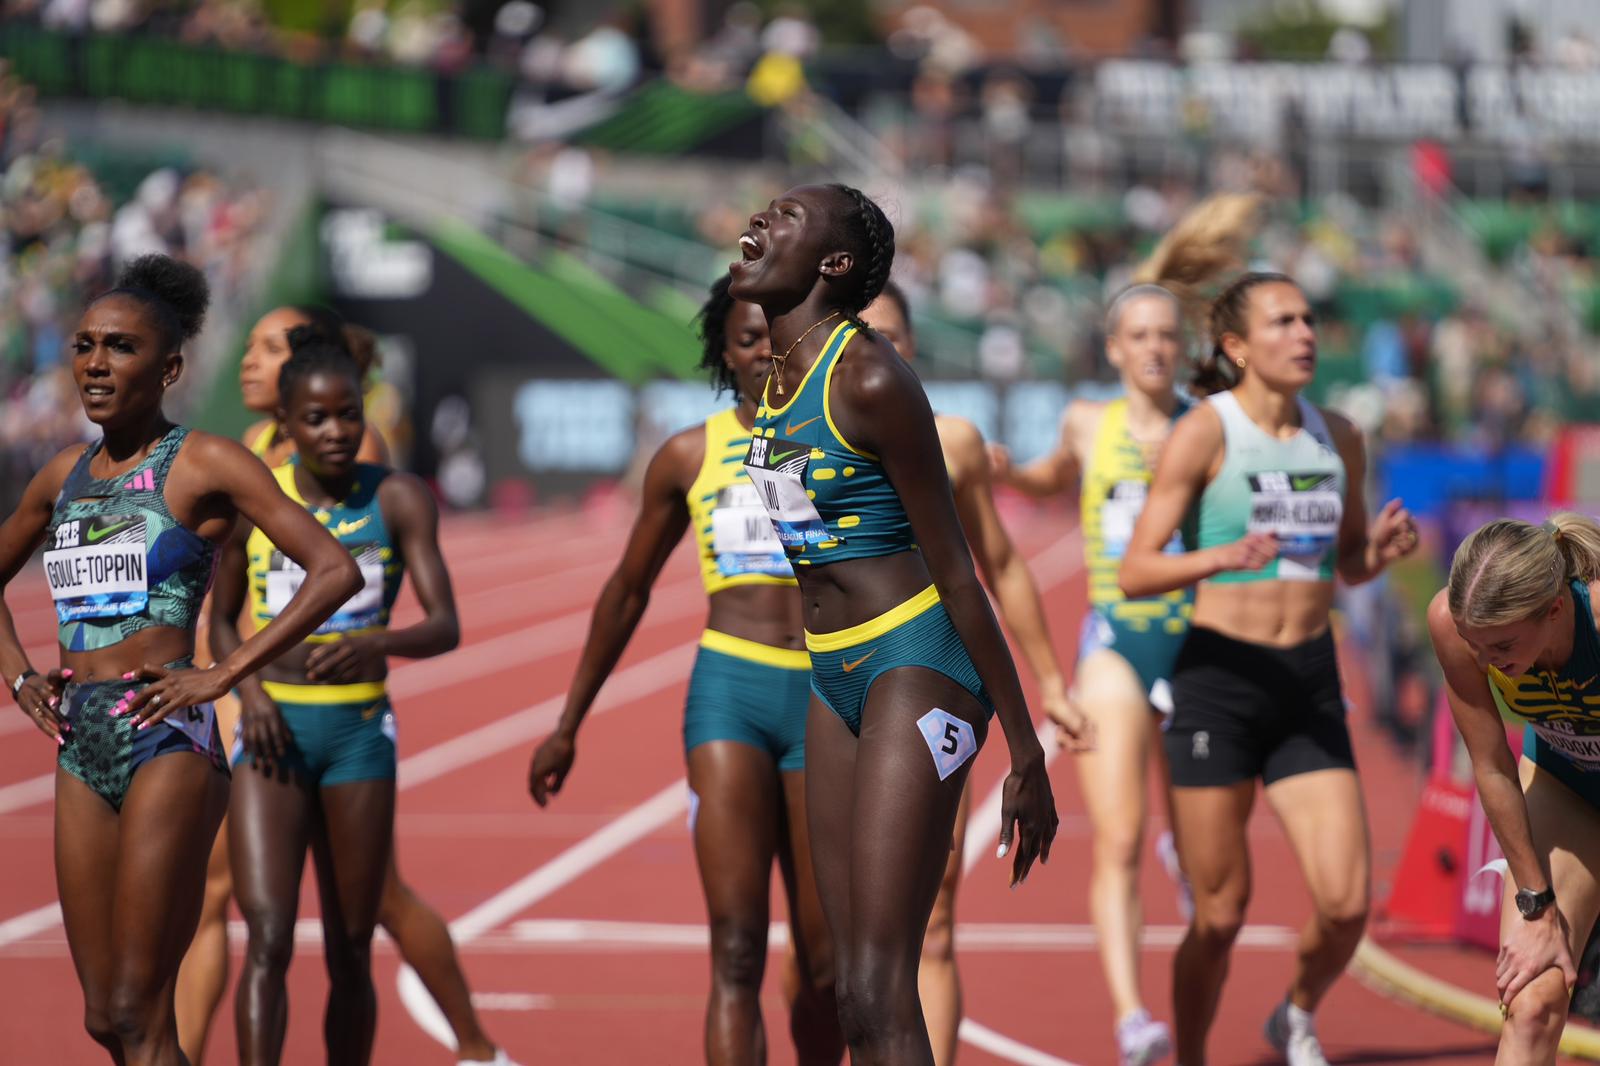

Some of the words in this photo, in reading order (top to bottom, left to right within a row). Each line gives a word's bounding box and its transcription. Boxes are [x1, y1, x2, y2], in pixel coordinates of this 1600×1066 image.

[749, 437, 768, 467] PRE
[55, 520, 80, 549] PRE
[47, 553, 143, 589] GOULE-TOPPIN
[941, 722, 959, 755] 5
